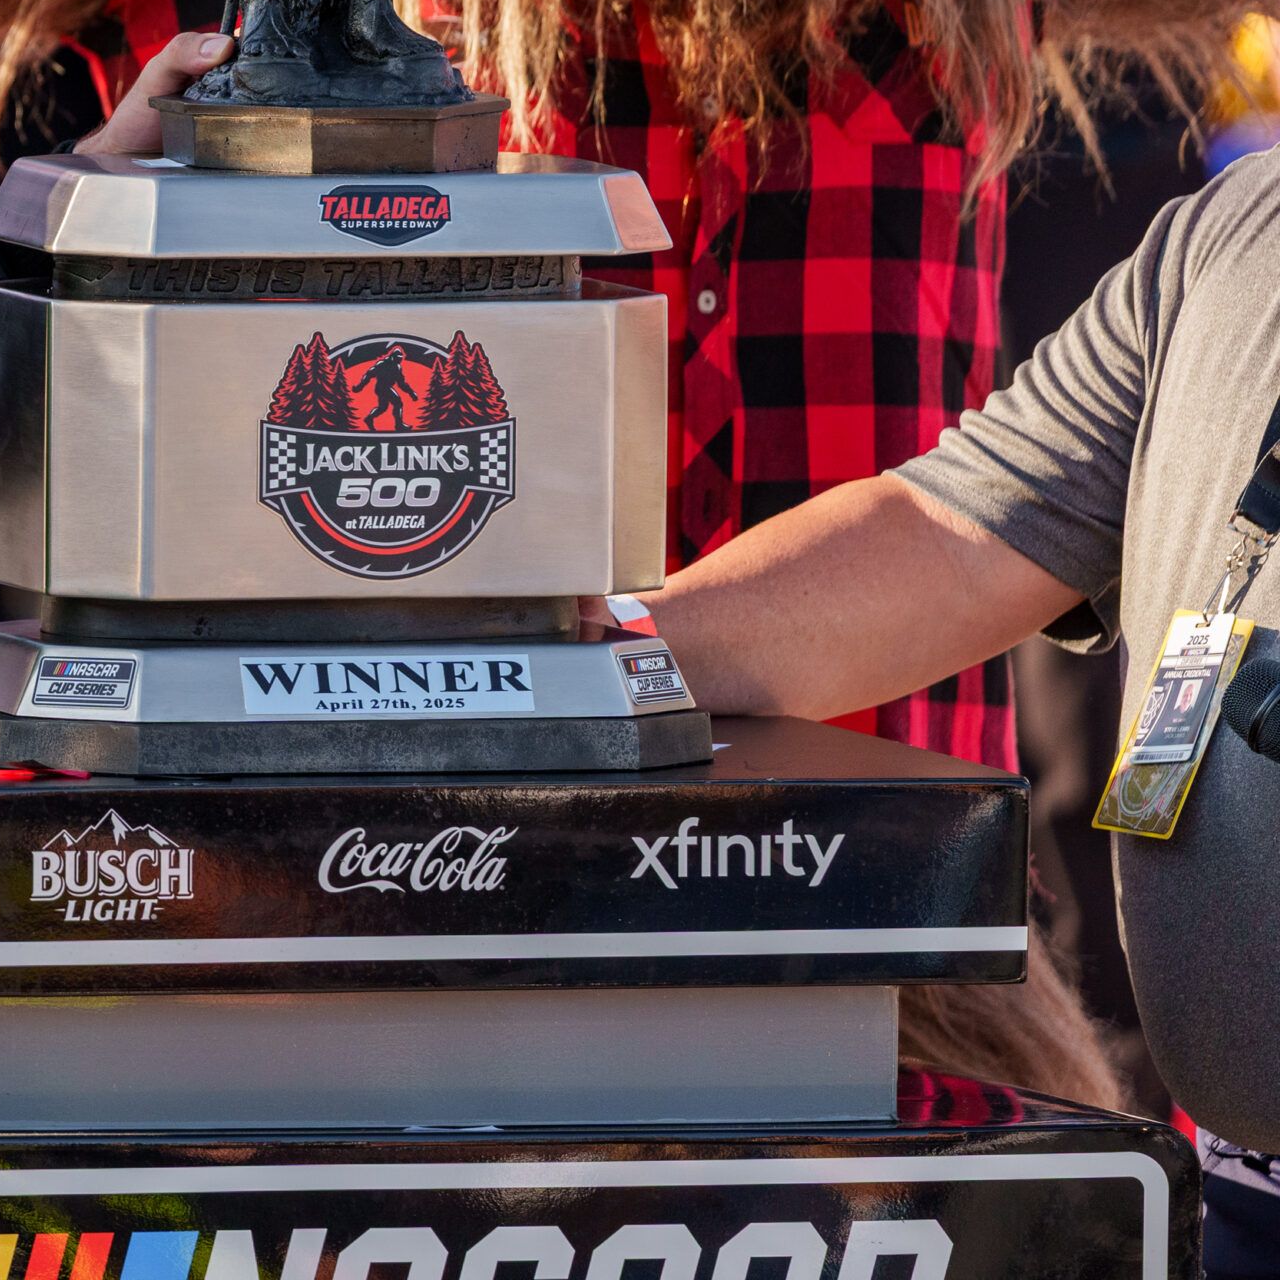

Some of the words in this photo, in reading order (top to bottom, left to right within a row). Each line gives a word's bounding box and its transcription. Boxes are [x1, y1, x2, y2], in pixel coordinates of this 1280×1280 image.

[320, 194, 451, 220] TALLADEGA
[340, 220, 439, 229] SUPERSPEEDWAY
[126, 258, 240, 294] THIS
[252, 260, 308, 295] IS
[324, 256, 564, 297] TALLADEGA
[299, 443, 378, 475] JACK
[336, 477, 441, 507] 500
[345, 519, 357, 529] at
[357, 515, 425, 529] TALLADEGA
[1187, 634, 1210, 646] 2025
[68, 663, 120, 677] NASCAR
[639, 657, 667, 671] NASCAR
[48, 682, 74, 695] CUP
[73, 683, 117, 696] SERIES
[242, 661, 531, 695] WINNER
[637, 677, 650, 691] CUP
[651, 675, 674, 689] SERIES
[316, 699, 363, 712] April
[370, 698, 417, 710] 27th,
[424, 698, 465, 709] 2025
[318, 825, 519, 895] Coca-Cola
[631, 816, 845, 890] xfinity
[30, 848, 194, 902] BUSCH
[63, 898, 157, 922] LIGHT
